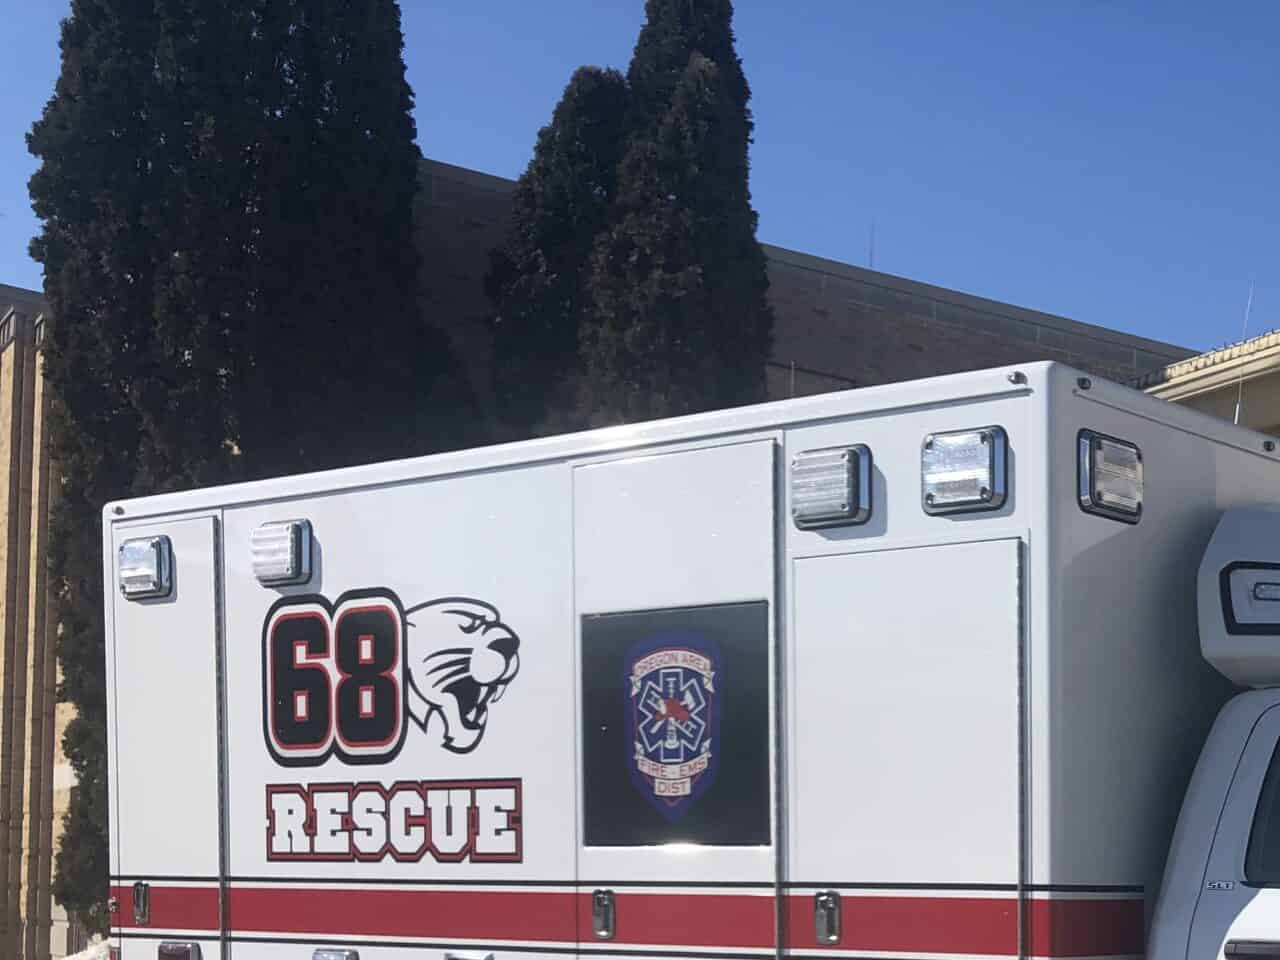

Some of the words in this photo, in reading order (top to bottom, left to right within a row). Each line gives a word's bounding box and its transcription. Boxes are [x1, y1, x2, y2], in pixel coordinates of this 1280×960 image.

[263, 588, 408, 768] 68
[639, 759, 667, 778] FIRE
[679, 759, 706, 777] EMS
[657, 780, 689, 794] DIST
[266, 778, 523, 863] RESCUE
